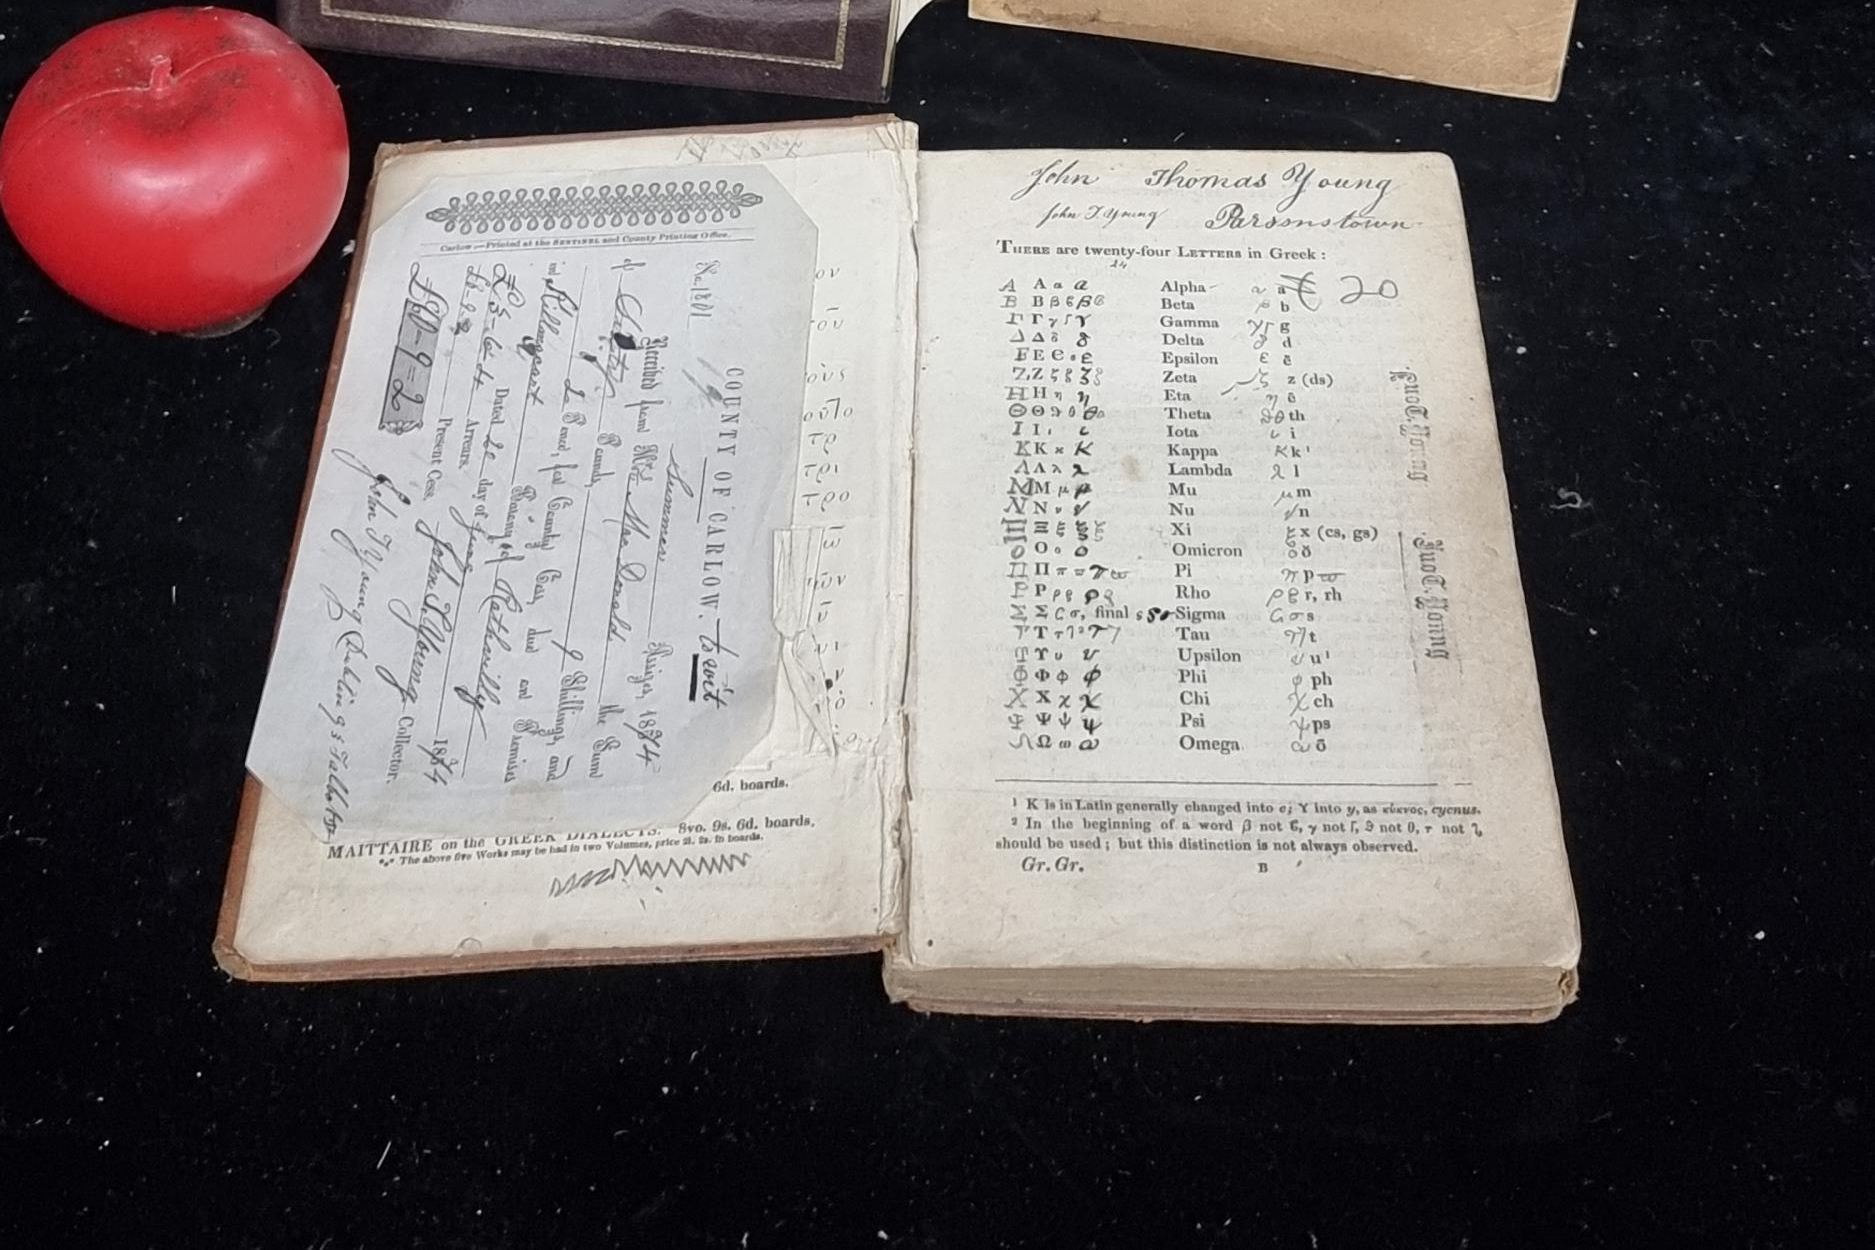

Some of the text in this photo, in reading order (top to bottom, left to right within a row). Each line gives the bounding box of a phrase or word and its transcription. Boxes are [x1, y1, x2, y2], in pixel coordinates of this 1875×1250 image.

[1011, 159, 1394, 217] John Thomas Young
[1055, 246, 1080, 256] are
[1085, 244, 1172, 259] twenty-four
[1176, 245, 1243, 259] LETTERS
[1247, 246, 1263, 260] in
[1159, 280, 1207, 295] Alpha
[1160, 297, 1196, 311] Beta
[1159, 314, 1220, 329] Gamma
[1161, 332, 1205, 346] Delta
[1161, 352, 1219, 368] Epsilon
[1162, 370, 1334, 391] Zeta (ds)
[1163, 388, 1192, 402] Eta
[1163, 406, 1212, 420] Theta
[1166, 424, 1200, 439] Iota
[457, 418, 481, 470] Arrears.
[471, 387, 511, 519] Dated day of
[1166, 443, 1219, 462] Kappa
[422, 417, 453, 502] Present Cess.
[1167, 461, 1233, 477] Lambda
[697, 367, 745, 621] COUNTY OF CARLOW.
[1168, 481, 1198, 497] Mu
[1167, 501, 1195, 517] Nu
[1170, 521, 1379, 543] Xi (cs, gs)
[1172, 542, 1243, 558] Omicron
[1174, 562, 1193, 578] Pi
[1175, 584, 1343, 602] Rho rh
[1094, 604, 1226, 624] final Sigma
[1174, 626, 1211, 642] Tau
[1177, 647, 1242, 667] Upsilon
[1177, 668, 1333, 691] Phi ph
[1179, 690, 1211, 707] Chi
[1179, 711, 1206, 729] Psi
[385, 715, 415, 785] Collector.
[1179, 734, 1241, 756] Omega
[711, 776, 791, 795] 6d. boards.
[1058, 798, 1073, 811] in
[1075, 798, 1113, 811] Latin
[1115, 797, 1179, 816] generally
[1184, 800, 1242, 817] changed
[1246, 800, 1275, 814] into
[1313, 801, 1343, 814] into
[326, 838, 434, 860] MAITTAIRE
[440, 841, 458, 851] on
[461, 835, 488, 849] the
[678, 821, 707, 835] 8vo.
[711, 819, 732, 833] 9s.
[736, 816, 759, 831] 6d.
[764, 813, 816, 829] boards.
[995, 835, 1042, 850] should
[1046, 835, 1064, 850] be
[1117, 836, 1144, 850] but
[1147, 836, 1174, 851] this
[1178, 837, 1252, 852] distinction
[1256, 838, 1269, 851] is
[1272, 839, 1297, 852] not
[1300, 838, 1348, 857] always
[1352, 839, 1419, 853] observed.
[1021, 855, 1051, 873] Gr.
[1054, 856, 1085, 873] Gr.
